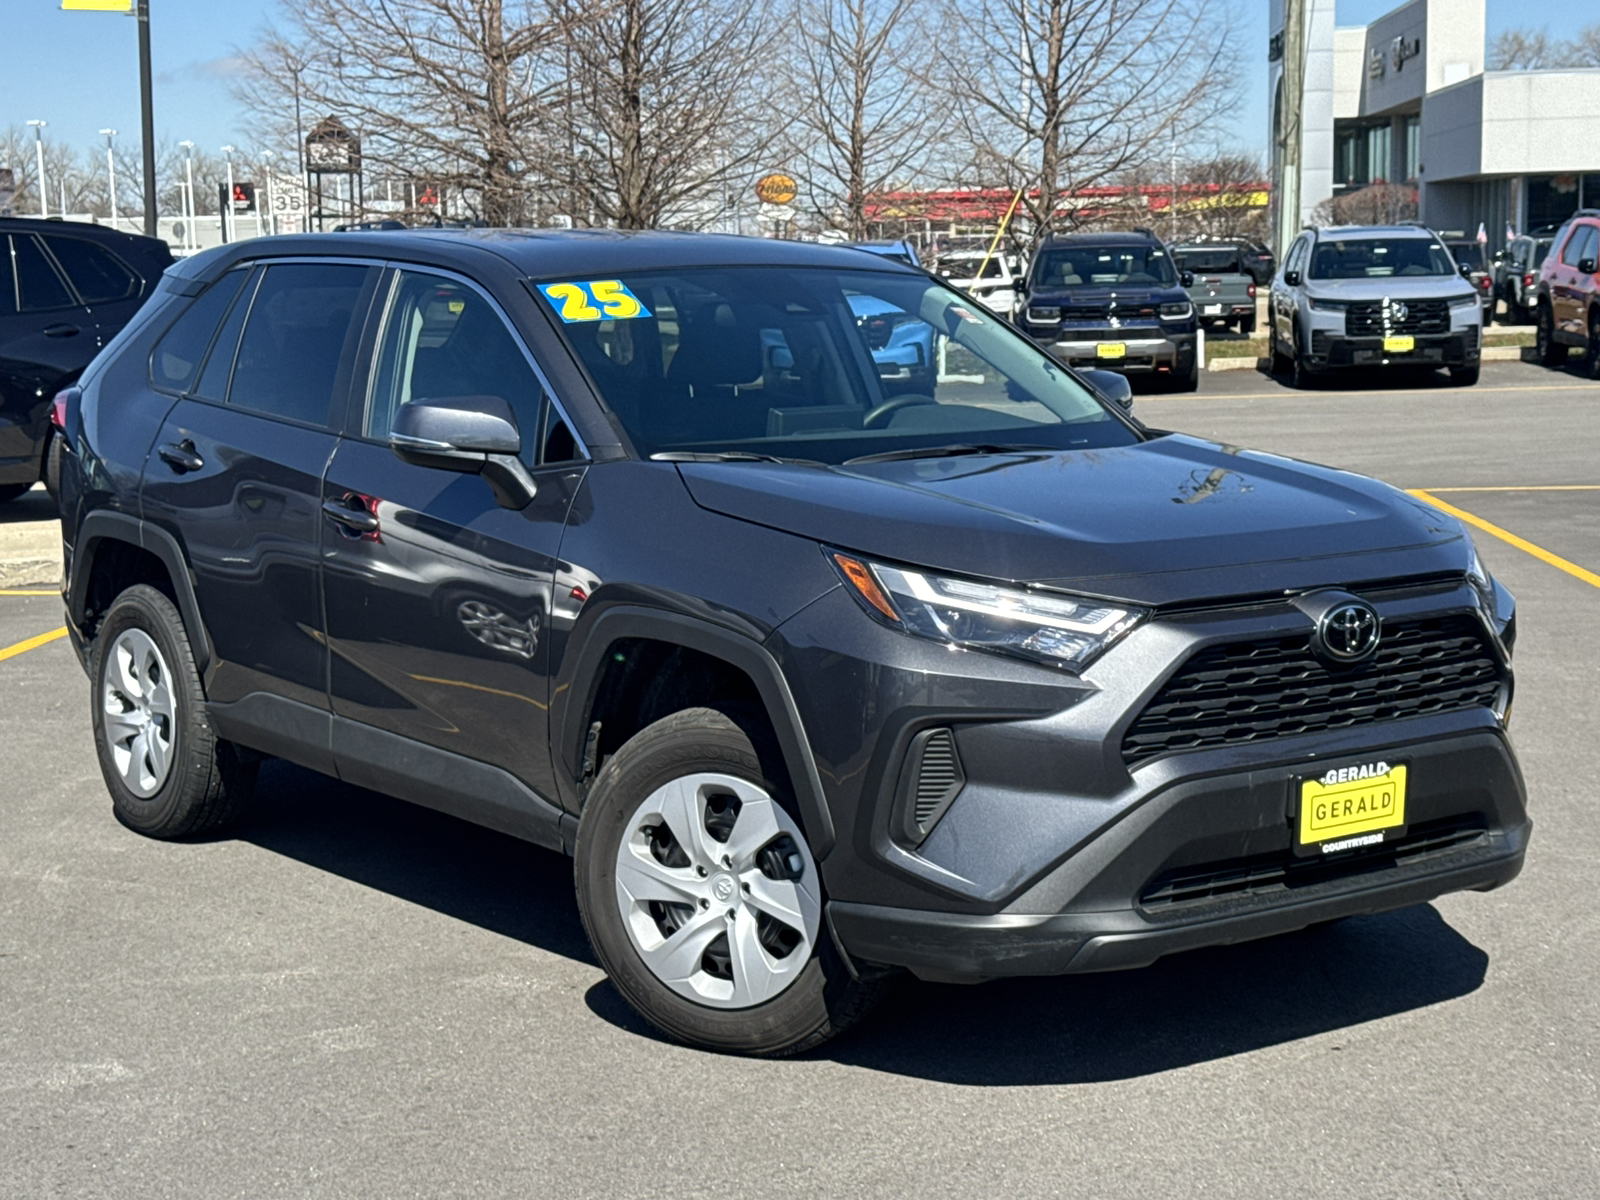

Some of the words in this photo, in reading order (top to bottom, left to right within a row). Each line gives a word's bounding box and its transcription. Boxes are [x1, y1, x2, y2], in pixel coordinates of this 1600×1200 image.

[275, 195, 301, 211] 35
[546, 281, 641, 320] 25
[1325, 761, 1388, 785] GERALD
[1316, 792, 1391, 821] GERALD
[1322, 833, 1384, 854] COUNTRYSIDE
